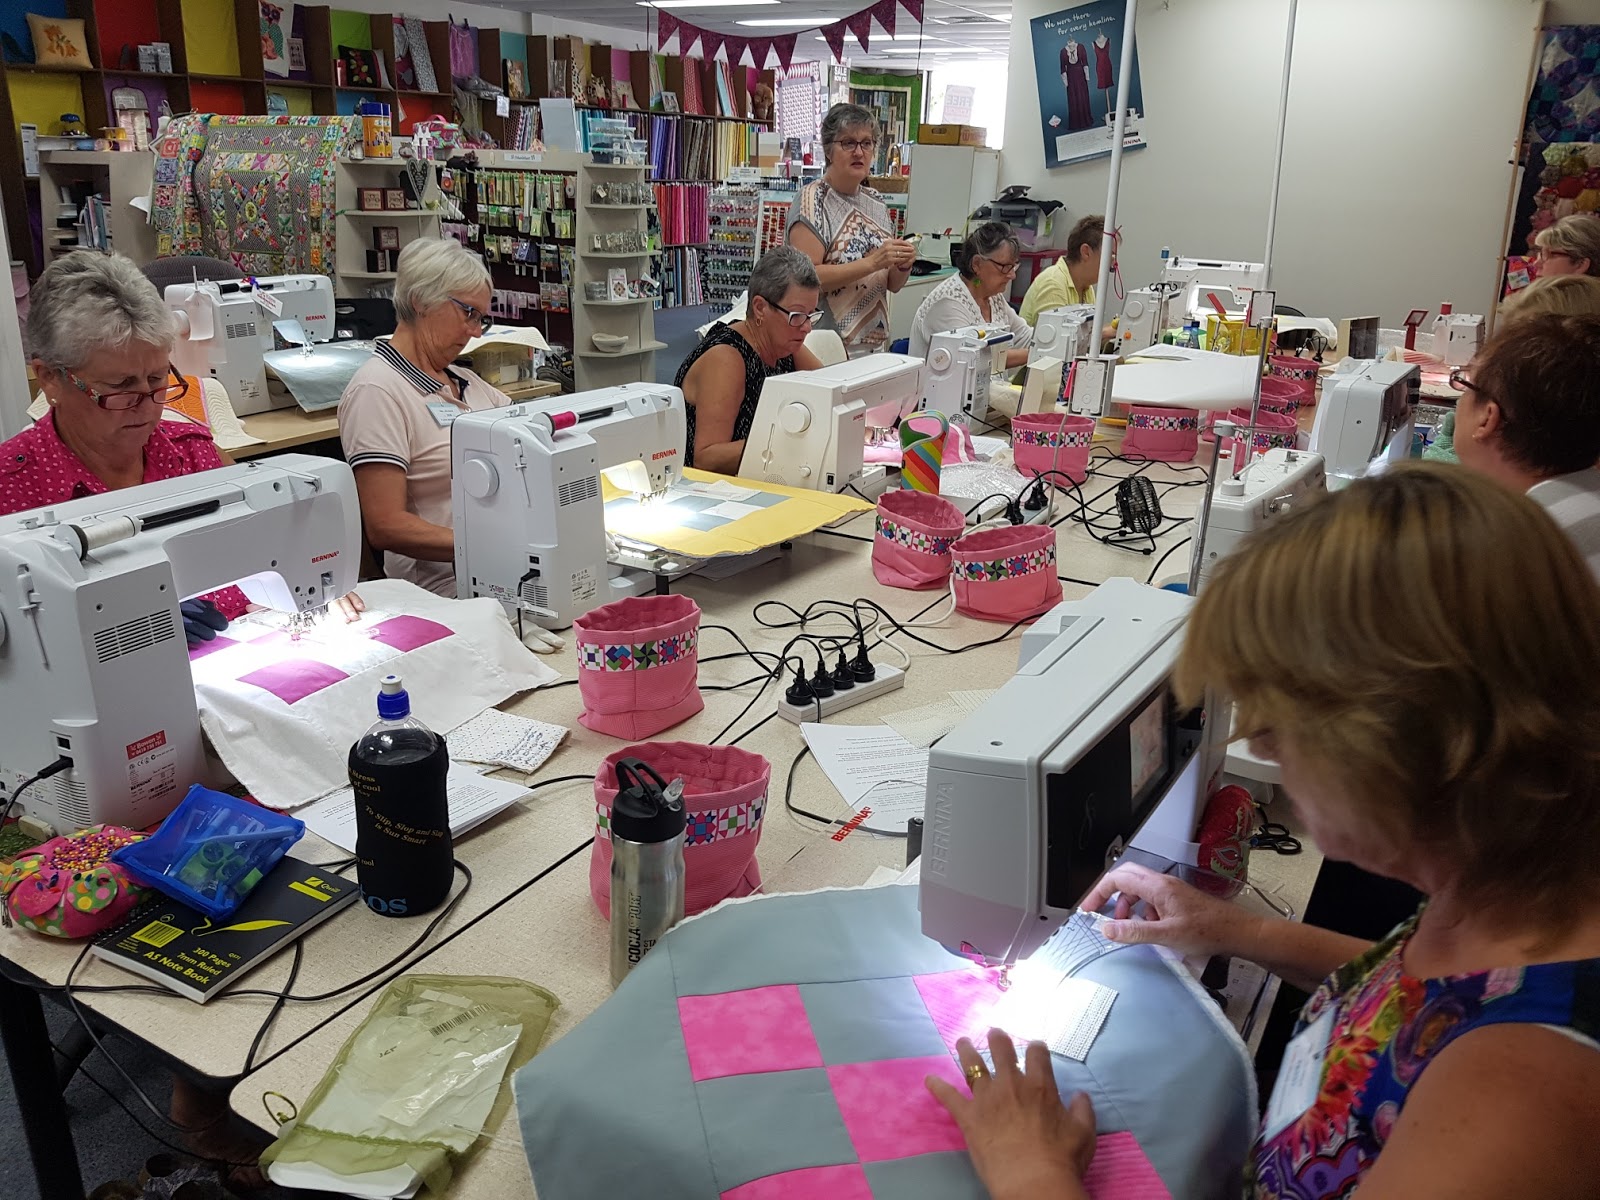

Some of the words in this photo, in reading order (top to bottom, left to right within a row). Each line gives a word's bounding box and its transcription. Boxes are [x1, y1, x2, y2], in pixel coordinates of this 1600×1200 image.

[1044, 19, 1056, 29] We
[1057, 18, 1072, 27] were
[1072, 12, 1091, 22] there
[1057, 28, 1068, 36] for
[1070, 22, 1088, 32] every
[1088, 16, 1116, 28] hemline.
[834, 66, 848, 76] SALE
[652, 448, 677, 461] BERNINA
[311, 551, 338, 564] BERNINA
[362, 783, 381, 793] cool
[365, 804, 374, 815] To
[374, 812, 393, 828] Slip,
[394, 821, 416, 836] Slop
[831, 806, 872, 842] BERNINA
[931, 782, 955, 878] BERNINA
[383, 827, 401, 839] Sun
[401, 833, 428, 846] Smart
[143, 951, 160, 961] A5
[158, 957, 184, 972] Note
[183, 967, 211, 985] Book
[176, 952, 198, 966] 7mm
[197, 961, 223, 976] Ruled
[192, 947, 209, 958] 300
[207, 954, 232, 969] Pages
